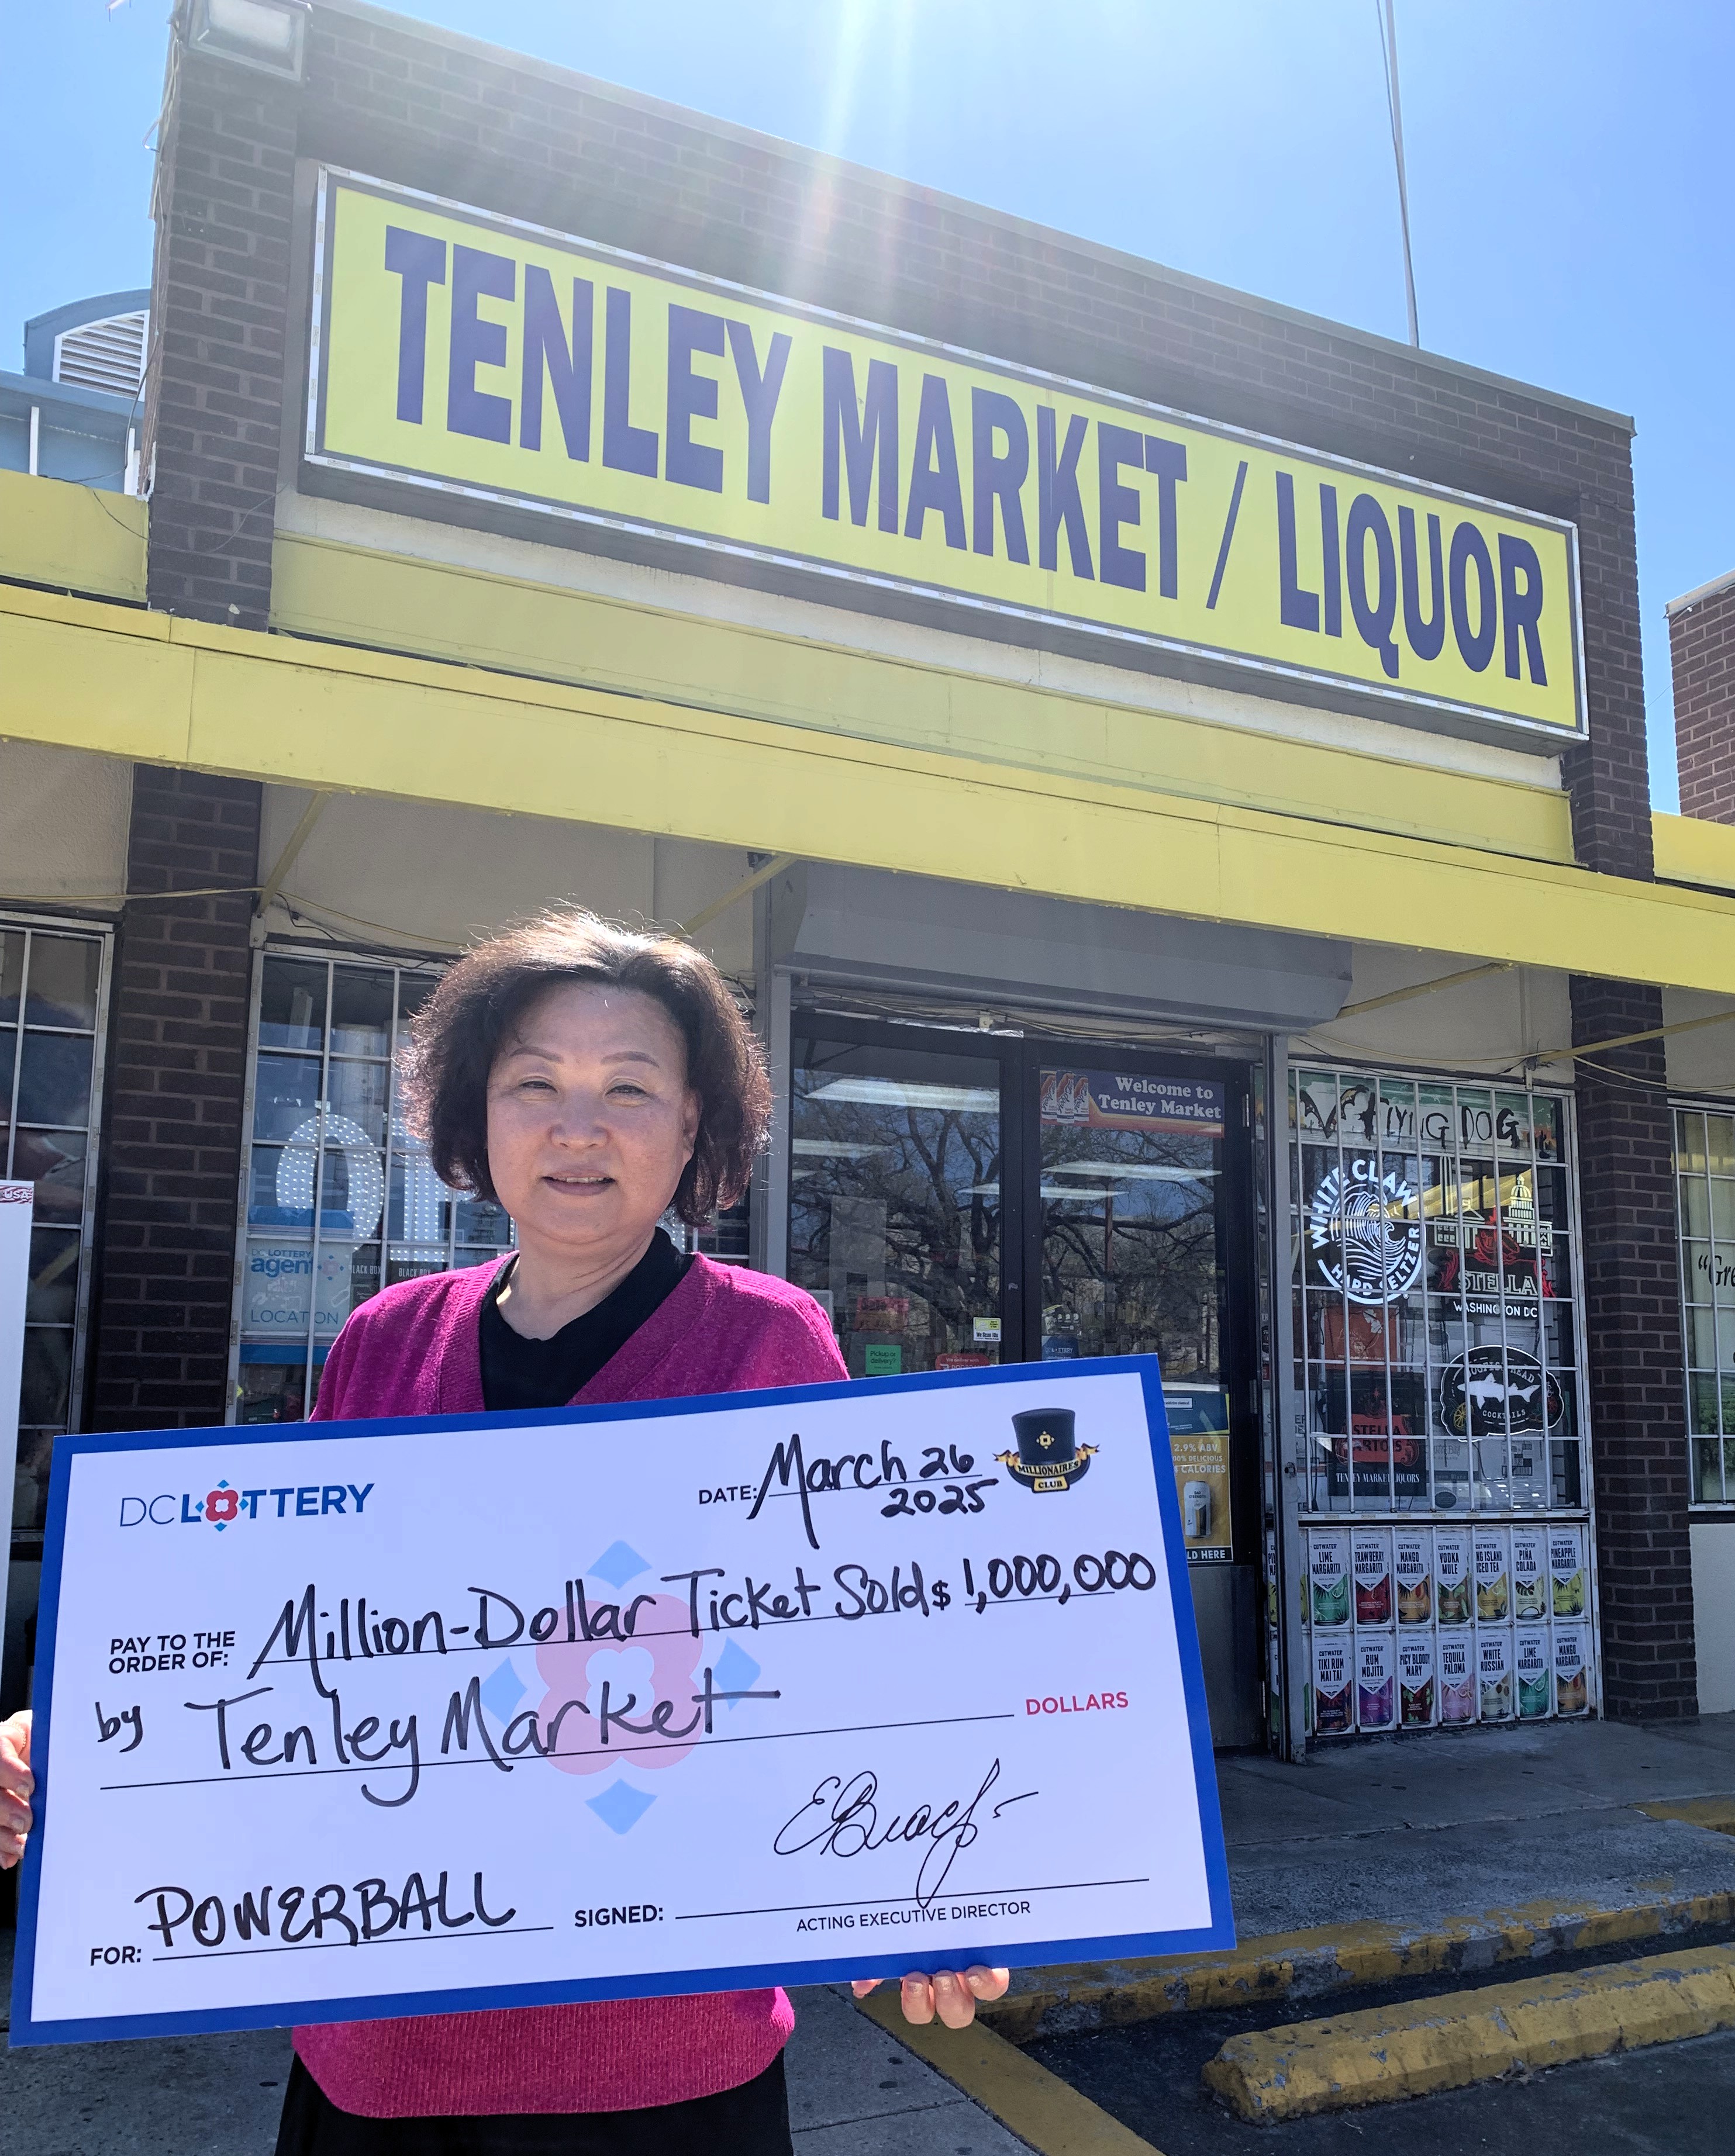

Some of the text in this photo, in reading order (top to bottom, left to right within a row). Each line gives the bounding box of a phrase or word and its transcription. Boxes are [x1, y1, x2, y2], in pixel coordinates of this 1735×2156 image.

[385, 224, 1548, 687] TENLEY MARKET / LIQUOR
[1115, 1077, 1213, 1099] Welcome to
[1098, 1094, 1222, 1119] Tenley Market
[1462, 1105, 1520, 1150] DOG
[5, 1190, 29, 1199] USA
[1310, 1159, 1418, 1249] WHITE CLAW
[268, 1249, 312, 1258] LOTTERY
[1331, 1228, 1420, 1296] HARD SELTZER
[351, 1264, 367, 1274] LACK
[399, 1267, 417, 1277] BLACK
[1453, 1301, 1537, 1318] WASHINGON DC
[250, 1309, 339, 1325] LOCATON
[1174, 1443, 1217, 1452] 2.9% ABV
[1352, 1439, 1402, 1452] ARTOS
[1017, 1460, 1079, 1476] MILLIONAIRES
[1181, 1465, 1226, 1474] CALORIES
[1038, 1480, 1063, 1488] CLUB
[1336, 1473, 1361, 1483] TENEY
[1394, 1473, 1420, 1484] IQUORS
[698, 1485, 758, 1505] DATE:
[746, 1433, 974, 1549] March 26
[880, 1477, 999, 1519] 2025
[1187, 1550, 1226, 1560] LD HERE
[1319, 1552, 1333, 1563] LIME
[1354, 1552, 1385, 1562] TRAWBERRY
[1400, 1552, 1419, 1562] MANGO
[1439, 1553, 1460, 1563] VODKA
[1485, 1551, 1502, 1561] ISLAND
[1519, 1548, 1533, 1561] PIÑA
[1551, 1548, 1576, 1559] PINEAPPLE
[1312, 1563, 1341, 1574] MARGARITA
[1355, 1563, 1384, 1574] MARGARITA
[1396, 1563, 1424, 1574] MARGARITA
[1442, 1564, 1458, 1575] MULE
[1476, 1562, 1499, 1573] ICED TEA
[1516, 1561, 1537, 1571] COLADA
[1552, 1559, 1577, 1569] MARGARITA
[247, 1561, 930, 1698] Million-Dollar Ticket Sold
[111, 1631, 235, 1655] PAY TO THE
[1483, 1649, 1501, 1660] WHITE
[1524, 1647, 1537, 1658] LIME
[1559, 1644, 1577, 1656] MANGO
[109, 1651, 229, 1674] ORDER OF:
[1318, 1658, 1344, 1670] TIKI RUM
[1366, 1654, 1379, 1665] RUM
[1400, 1653, 1430, 1665] PICY BLOODY
[1442, 1652, 1465, 1664] TEQUILA
[1517, 1658, 1544, 1670] MARGARITA
[1555, 1655, 1581, 1667] MARGARITA
[1362, 1666, 1384, 1677] MOJITO
[1406, 1666, 1422, 1677] MARY
[1444, 1663, 1465, 1674] PALOMA
[1481, 1660, 1504, 1672] RUSSIAN
[1320, 1670, 1342, 1682] MAI TAI
[1026, 1691, 1130, 1718] DOLLARS
[96, 1667, 781, 1808] by Tenley Market
[134, 1871, 517, 1947] POWERBALL
[574, 1904, 664, 1928] SIGNED:
[796, 1901, 1032, 1932] ACTING EXECUTIVE DIRECTOR
[89, 1947, 143, 1967] FOR:
